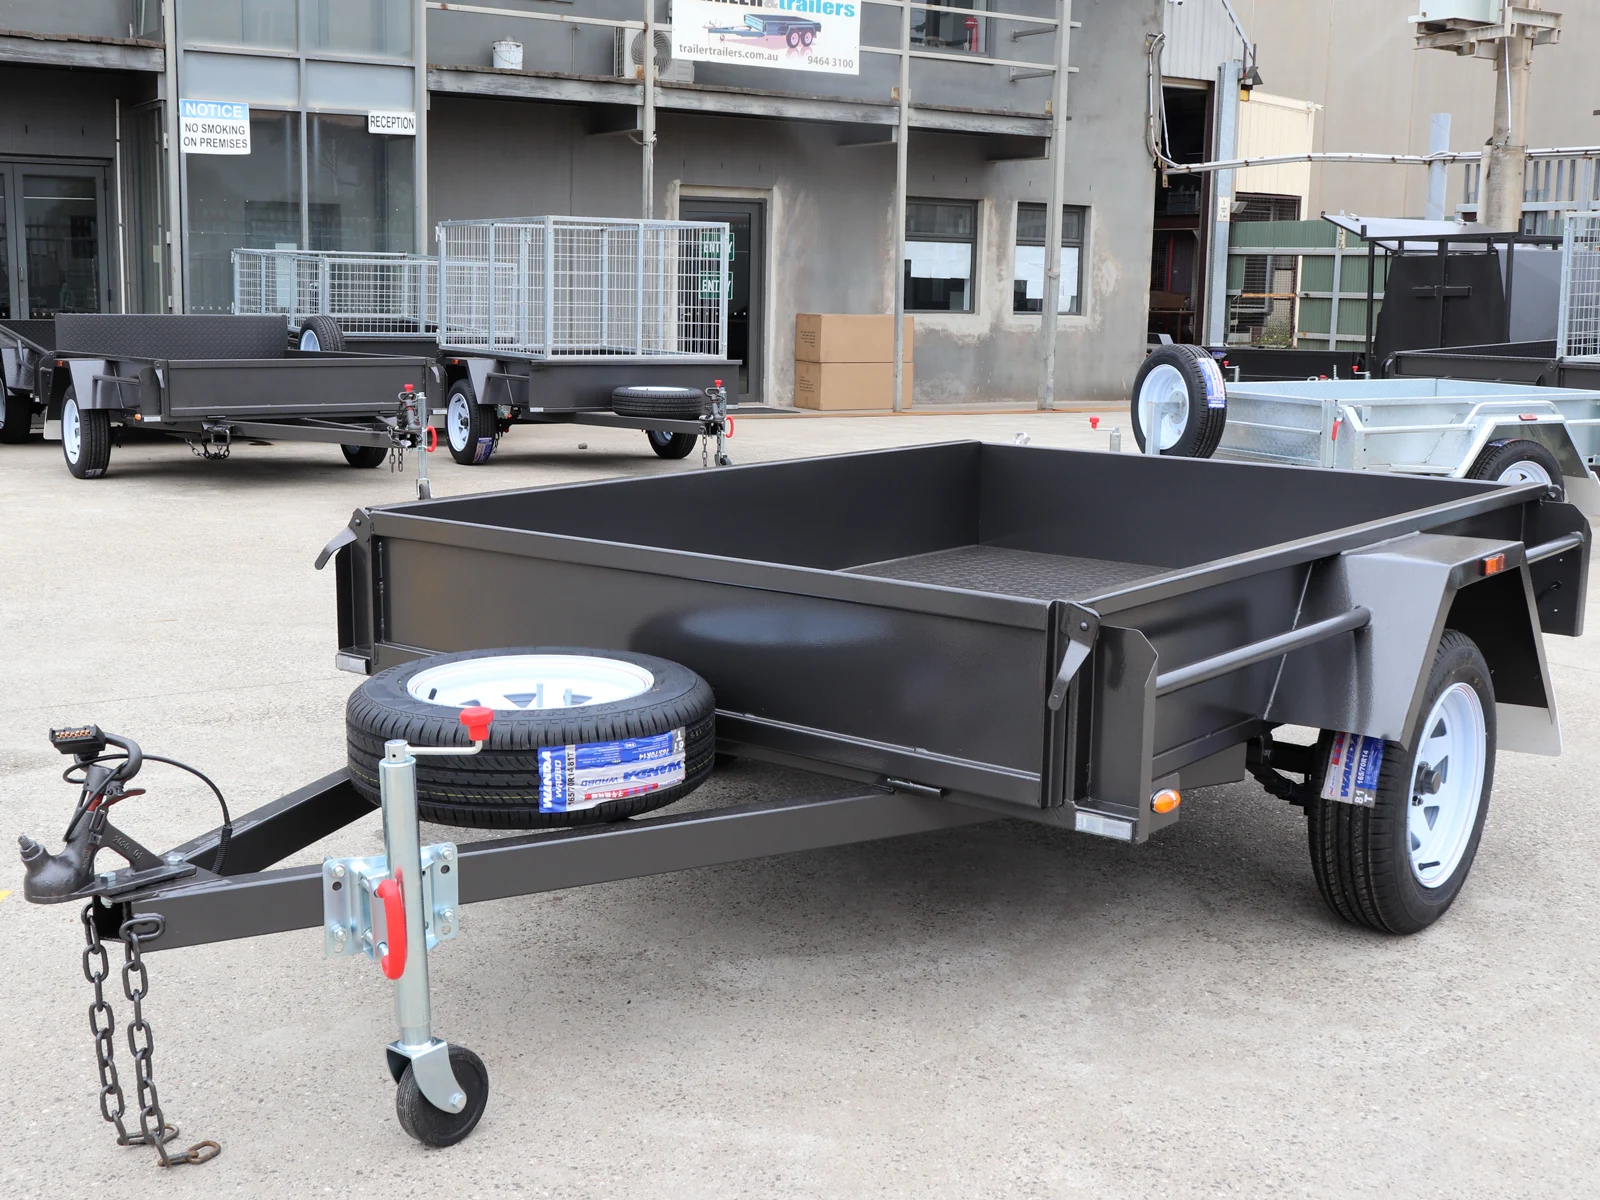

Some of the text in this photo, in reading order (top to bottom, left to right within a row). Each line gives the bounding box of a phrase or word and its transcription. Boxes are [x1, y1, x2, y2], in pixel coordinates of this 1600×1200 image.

[679, 44, 779, 61] trailertrailers.com.au
[807, 56, 854, 68] 9464 3100
[185, 102, 243, 118] NOTICE
[185, 123, 246, 135] NO SMOKING
[370, 115, 415, 130] RECEPTION
[183, 136, 248, 149] ON PREMISES
[703, 241, 733, 253] ENTY
[702, 280, 731, 292] ENTY
[623, 760, 682, 782] WANDA
[1341, 732, 1360, 797] WANDA
[1356, 750, 1369, 784] 165/70R14
[541, 750, 553, 808] WANDA
[1354, 789, 1365, 804] 81
[1364, 794, 1374, 803] T
